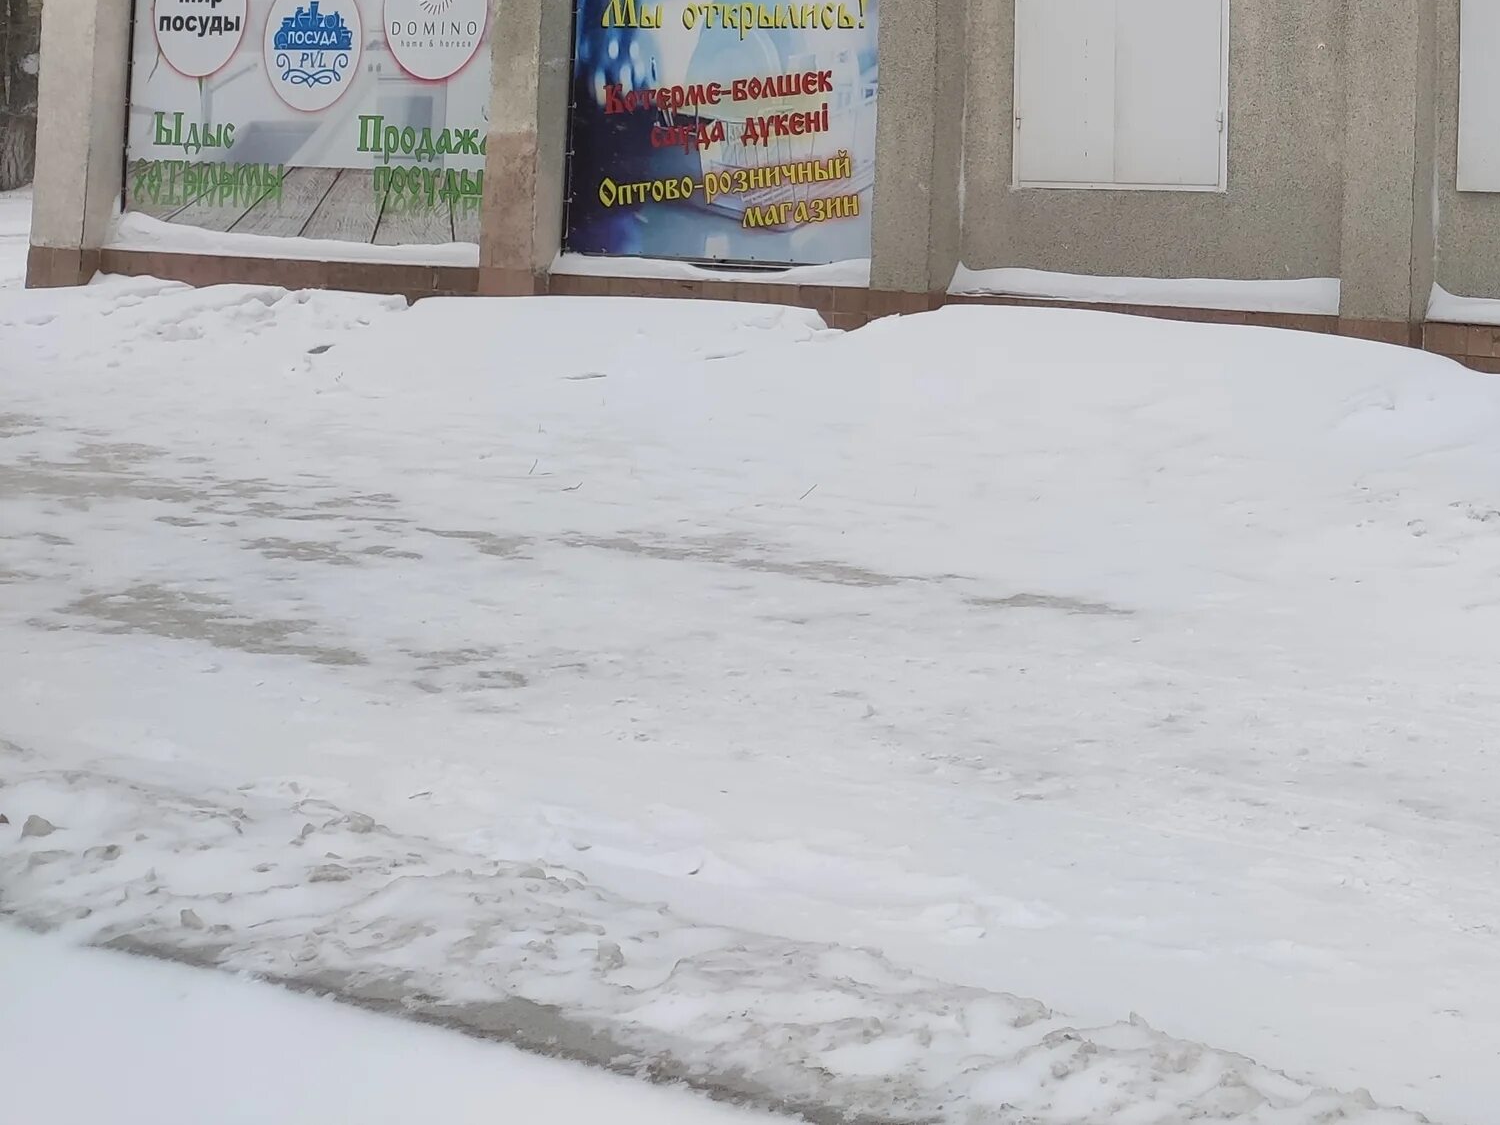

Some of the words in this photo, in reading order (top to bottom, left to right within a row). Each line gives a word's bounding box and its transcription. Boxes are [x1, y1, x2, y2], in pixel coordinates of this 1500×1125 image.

[159, 15, 240, 37] посуды
[287, 31, 338, 46] ПОСУДА
[391, 21, 477, 36] DOMINO
[152, 111, 236, 155] Ыдыс
[373, 166, 484, 206] посуды
[599, 149, 852, 208] Оптово-розничный
[741, 195, 859, 228] магазин
